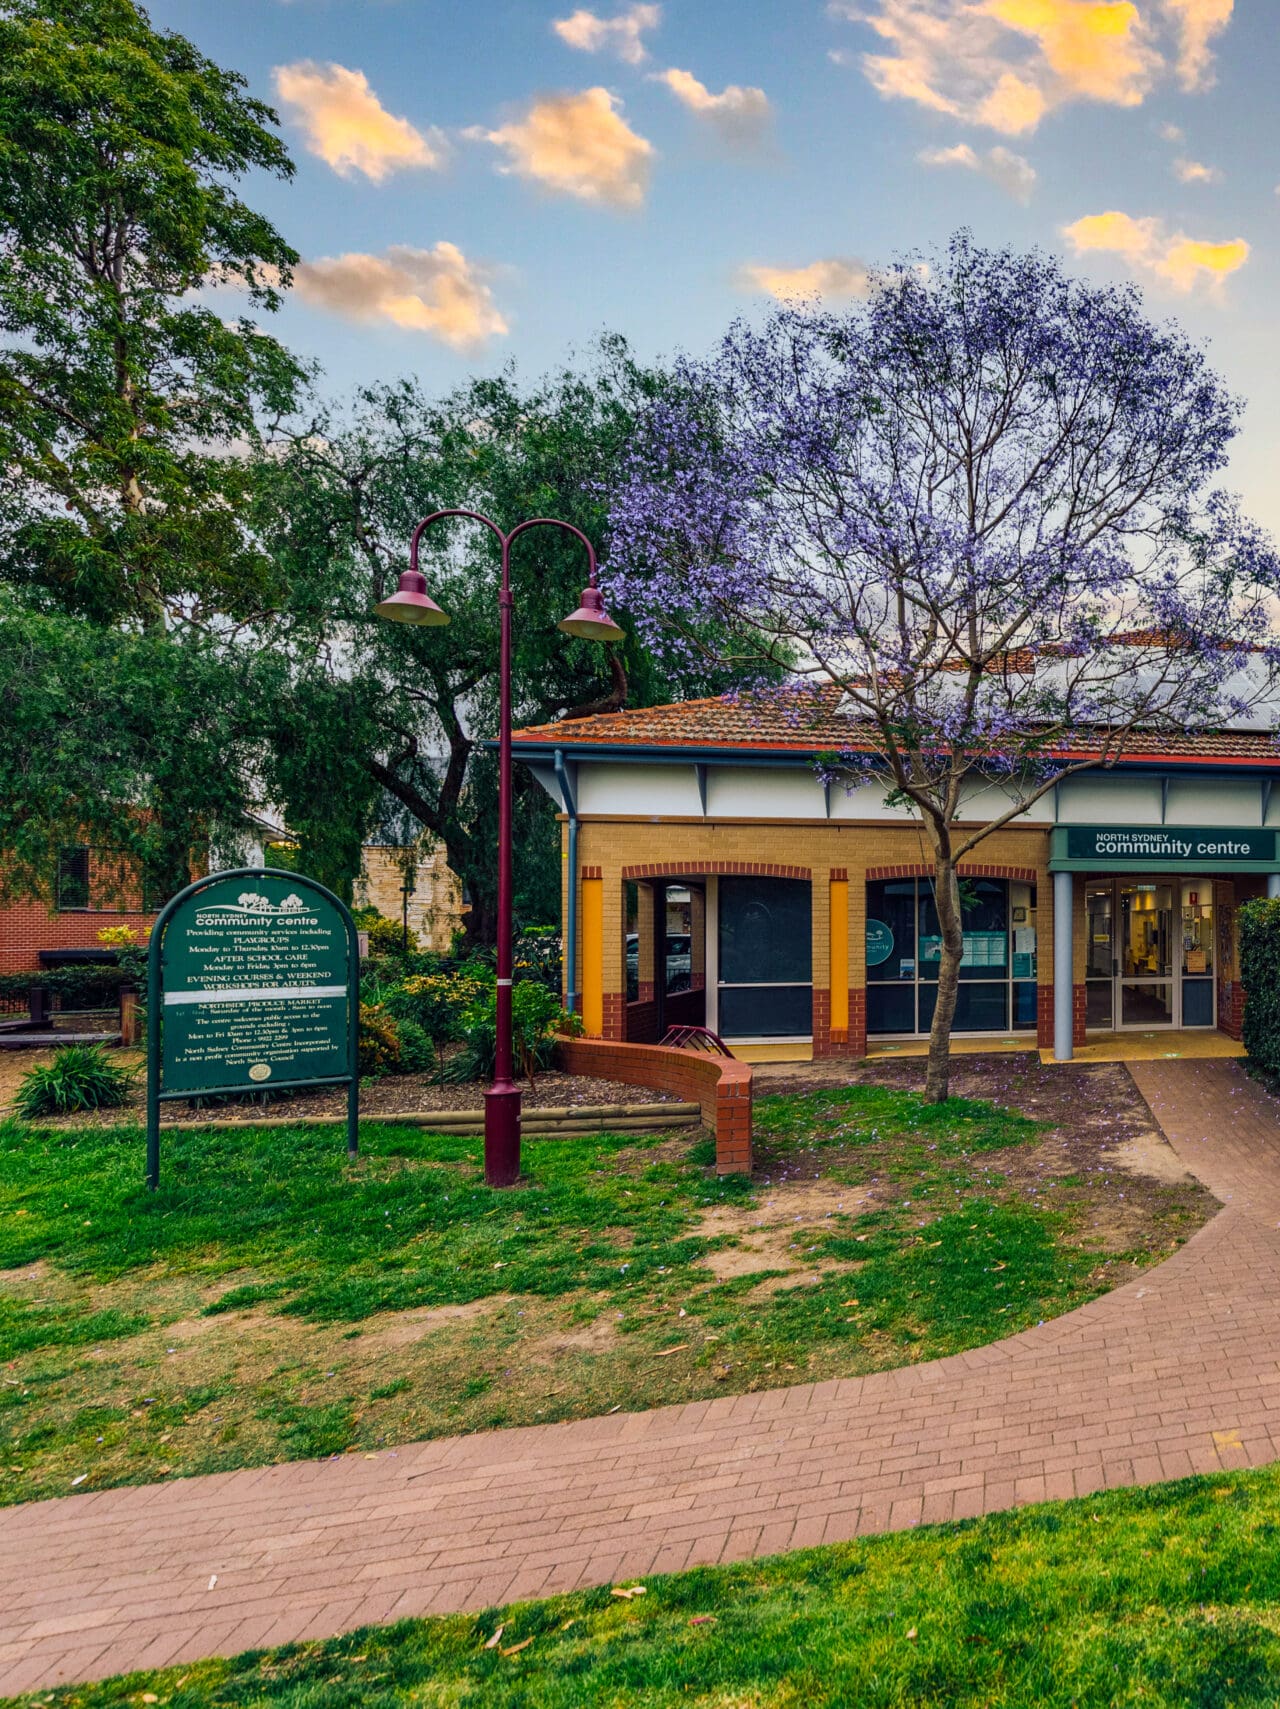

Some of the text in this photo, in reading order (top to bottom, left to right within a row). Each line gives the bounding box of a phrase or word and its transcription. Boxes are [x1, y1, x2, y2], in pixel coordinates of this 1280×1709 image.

[1096, 833, 1169, 842] NORTH SYDNEY
[1095, 840, 1250, 857] community centre
[195, 916, 318, 927] community centre
[299, 928, 332, 936] including
[233, 936, 289, 944] PLAYGROUPS
[213, 955, 245, 963] AFTER
[187, 975, 230, 983] EVENING
[287, 971, 332, 979] WEEKEND
[203, 982, 260, 990] WORKSHOPS
[198, 1001, 246, 1009] NORTHSIDE
[263, 1014, 281, 1022] public
[184, 1047, 205, 1055] North
[231, 1043, 269, 1051] Community
[224, 1050, 261, 1058] community
[225, 1058, 245, 1066] North
